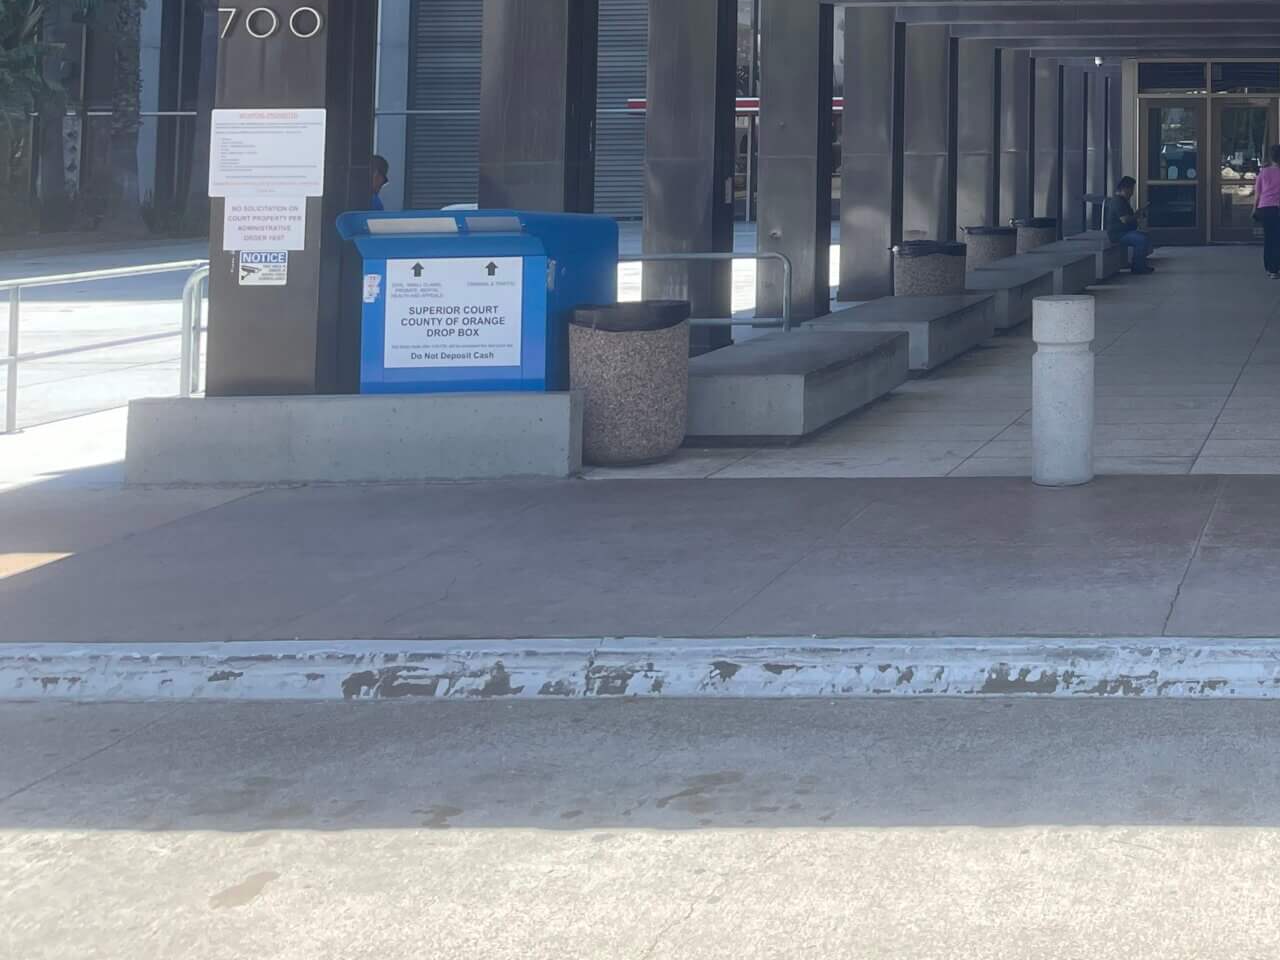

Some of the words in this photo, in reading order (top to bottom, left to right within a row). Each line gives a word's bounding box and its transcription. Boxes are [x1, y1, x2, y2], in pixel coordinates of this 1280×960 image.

[217, 6, 321, 39] 700
[242, 252, 285, 263] NOTICE
[408, 306, 461, 315] SUPERIOR
[463, 305, 499, 314] COURT
[401, 317, 443, 326] COUNTY
[445, 317, 460, 326] OF
[462, 316, 505, 325] ORANGE
[426, 328, 455, 338] DROP
[458, 328, 480, 337] BOX
[410, 352, 422, 360] Do
[424, 352, 438, 360] Not
[440, 351, 472, 361] Deposit
[473, 351, 495, 360] Cash
